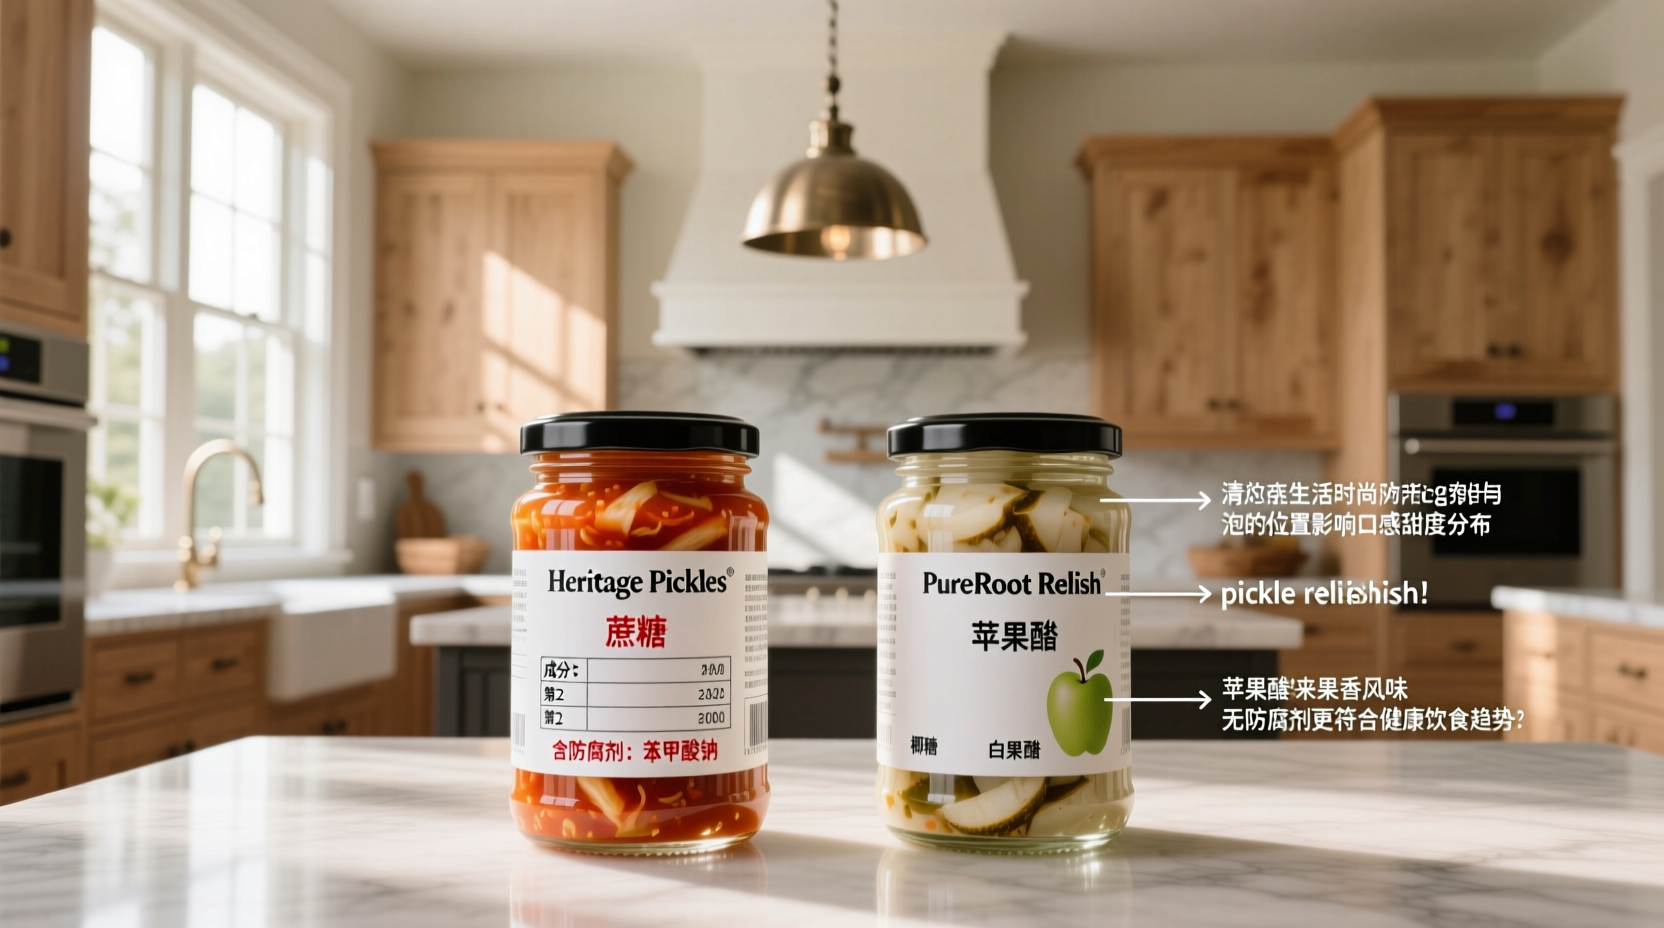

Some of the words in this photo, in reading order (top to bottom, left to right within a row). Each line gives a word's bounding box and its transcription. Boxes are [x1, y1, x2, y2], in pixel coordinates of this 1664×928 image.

[548, 569, 643, 600] Heritage
[923, 571, 1032, 595] PureRoot
[605, 614, 668, 648] 蔗糖
